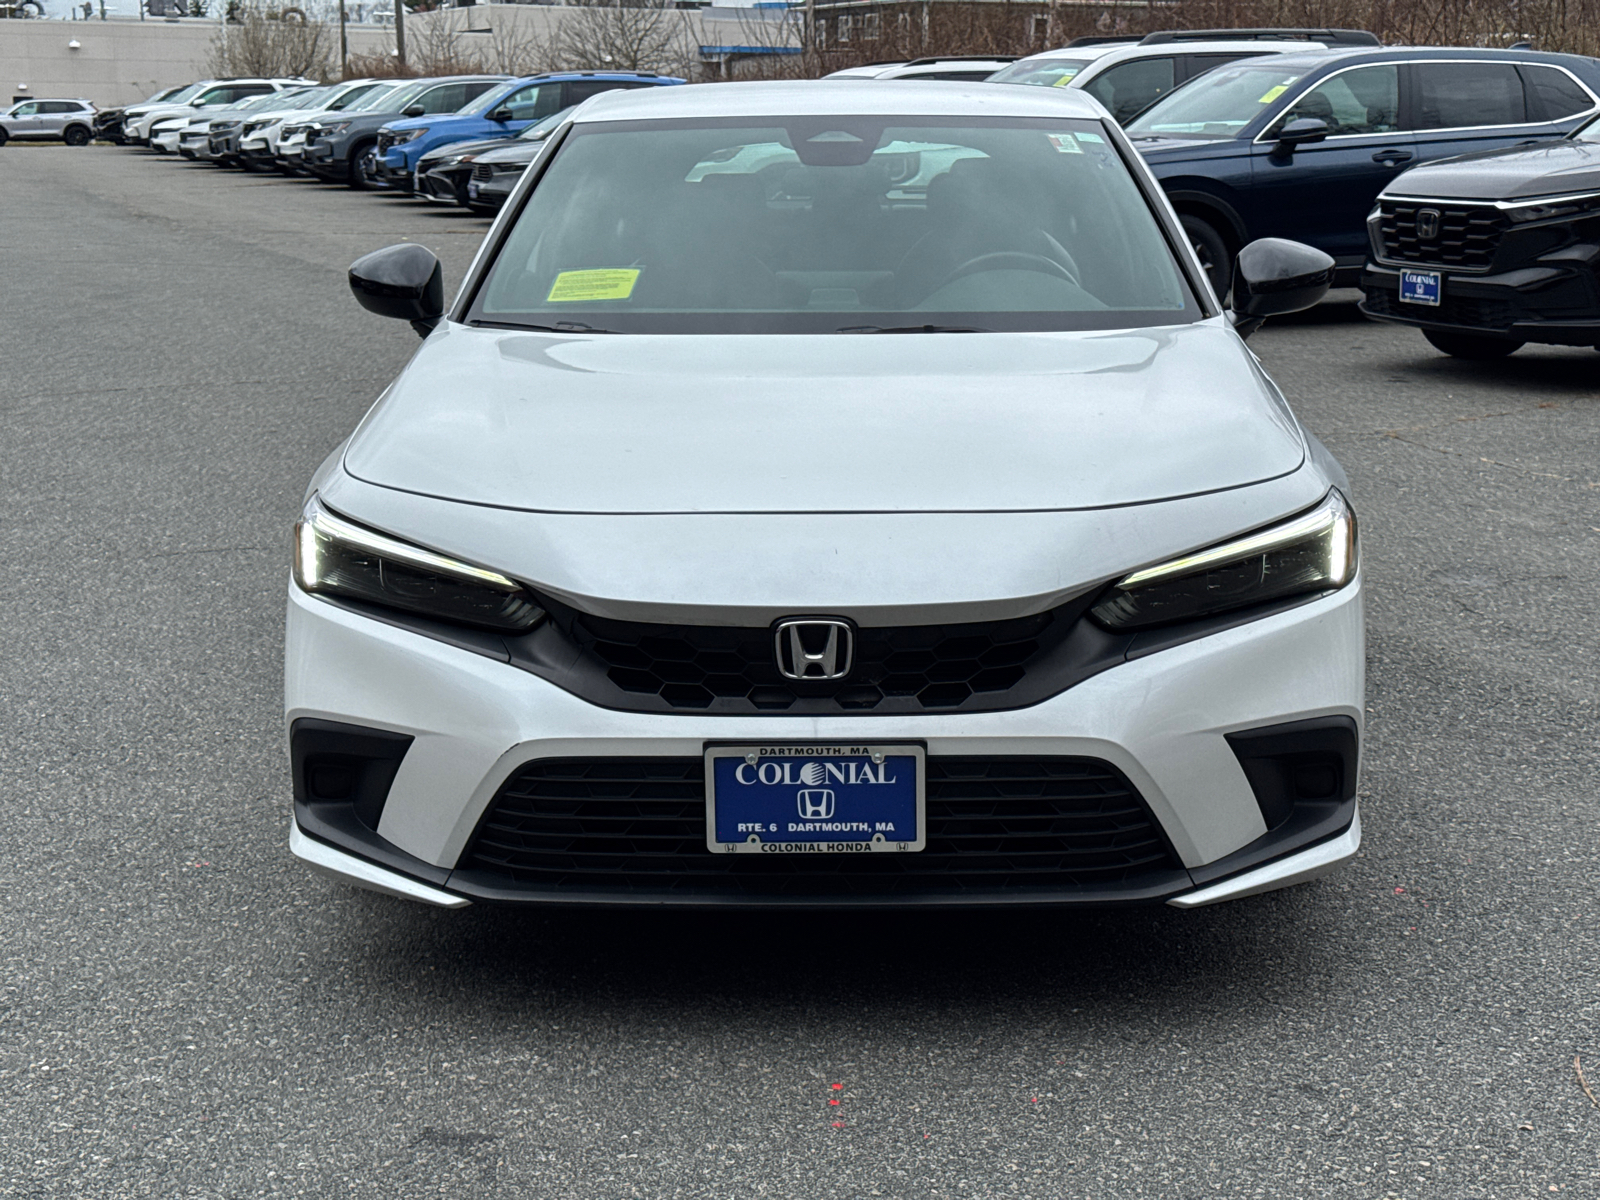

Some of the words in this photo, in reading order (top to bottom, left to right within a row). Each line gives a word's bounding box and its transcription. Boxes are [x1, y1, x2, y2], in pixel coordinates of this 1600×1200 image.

[759, 747, 847, 756] DARTMOUTH,
[850, 747, 870, 755] MA
[735, 762, 897, 786] COLONIAL
[737, 823, 767, 833] RTE.
[769, 823, 778, 833] 6
[788, 822, 872, 833] DARTMOUTH,
[875, 822, 895, 832] MA
[761, 843, 825, 853] COLONIAL
[827, 843, 872, 852] HONDA
